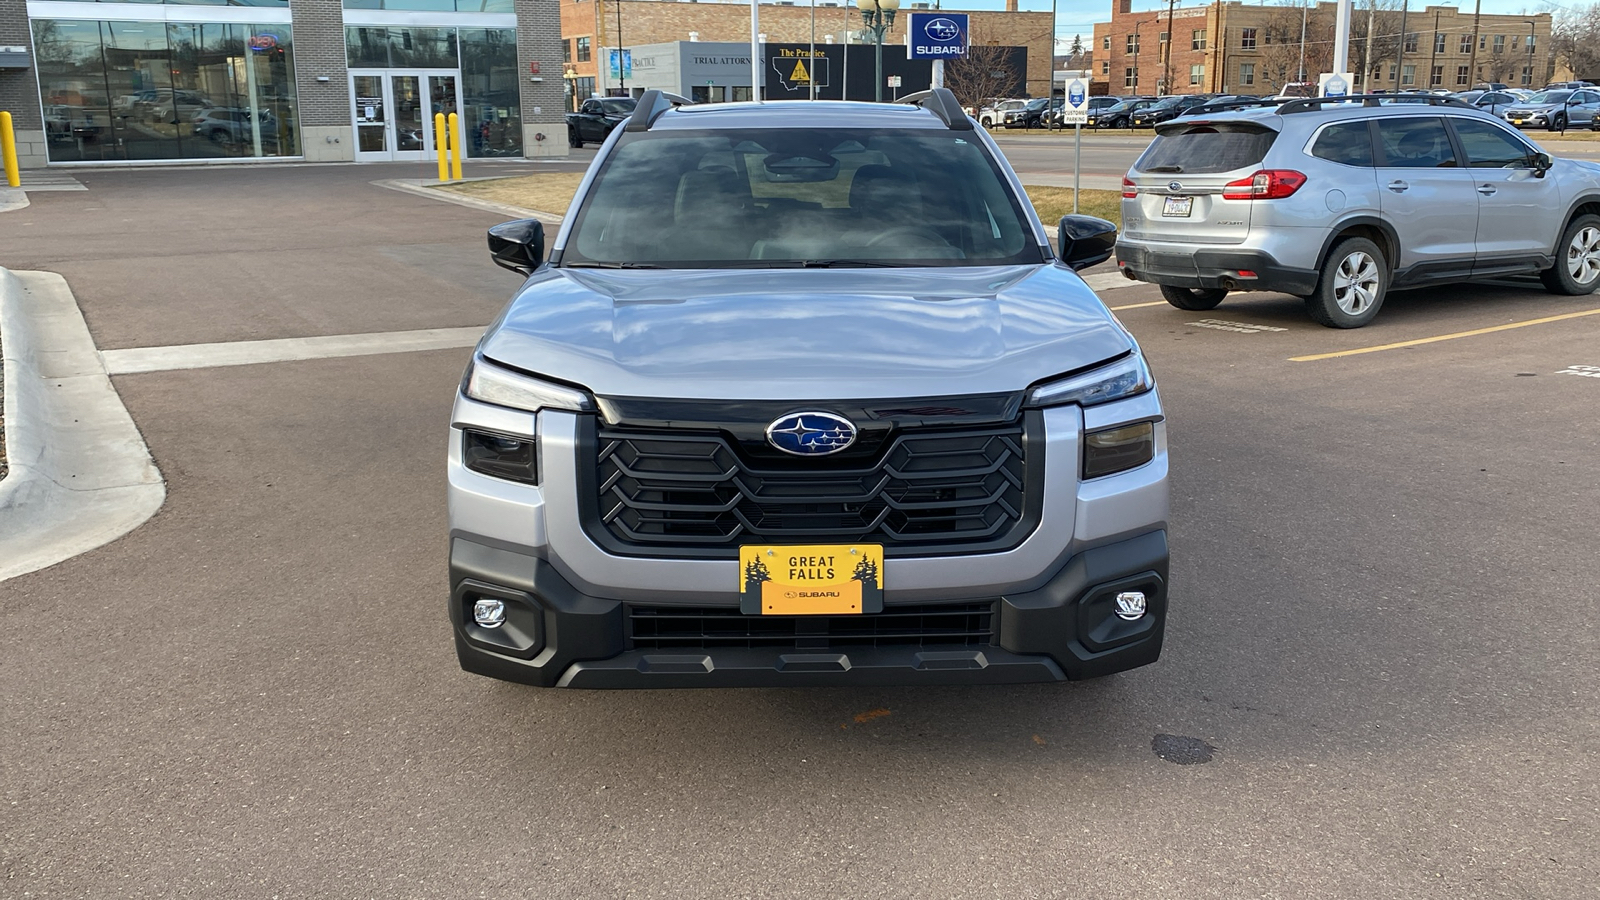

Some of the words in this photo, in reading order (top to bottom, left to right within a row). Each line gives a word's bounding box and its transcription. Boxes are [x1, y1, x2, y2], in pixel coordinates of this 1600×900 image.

[780, 49, 795, 57] The
[796, 49, 825, 58] Pracice
[916, 46, 965, 54] SUBARU
[694, 57, 719, 65] TRIAL
[720, 57, 766, 65] ATTORNS
[789, 556, 835, 567] GREAT
[789, 568, 835, 580] FALLS
